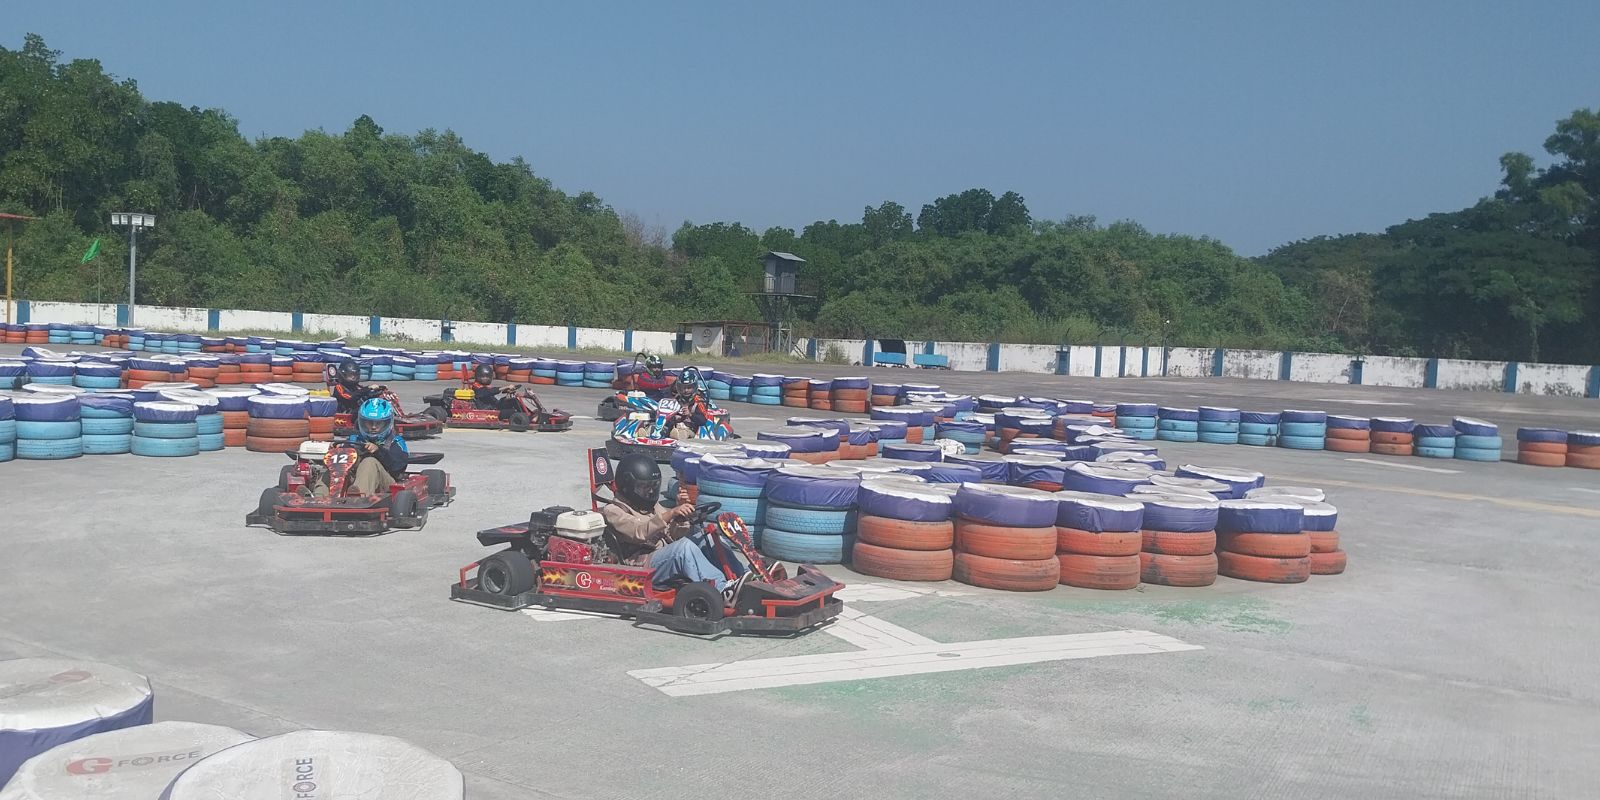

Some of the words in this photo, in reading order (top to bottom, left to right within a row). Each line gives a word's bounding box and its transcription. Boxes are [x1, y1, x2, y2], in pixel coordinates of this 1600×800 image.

[662, 400, 675, 409] 24
[330, 454, 349, 464] 12
[727, 520, 742, 534] 14
[576, 571, 591, 589] G
[117, 751, 200, 768] FORCE
[293, 757, 317, 799] FORCE
